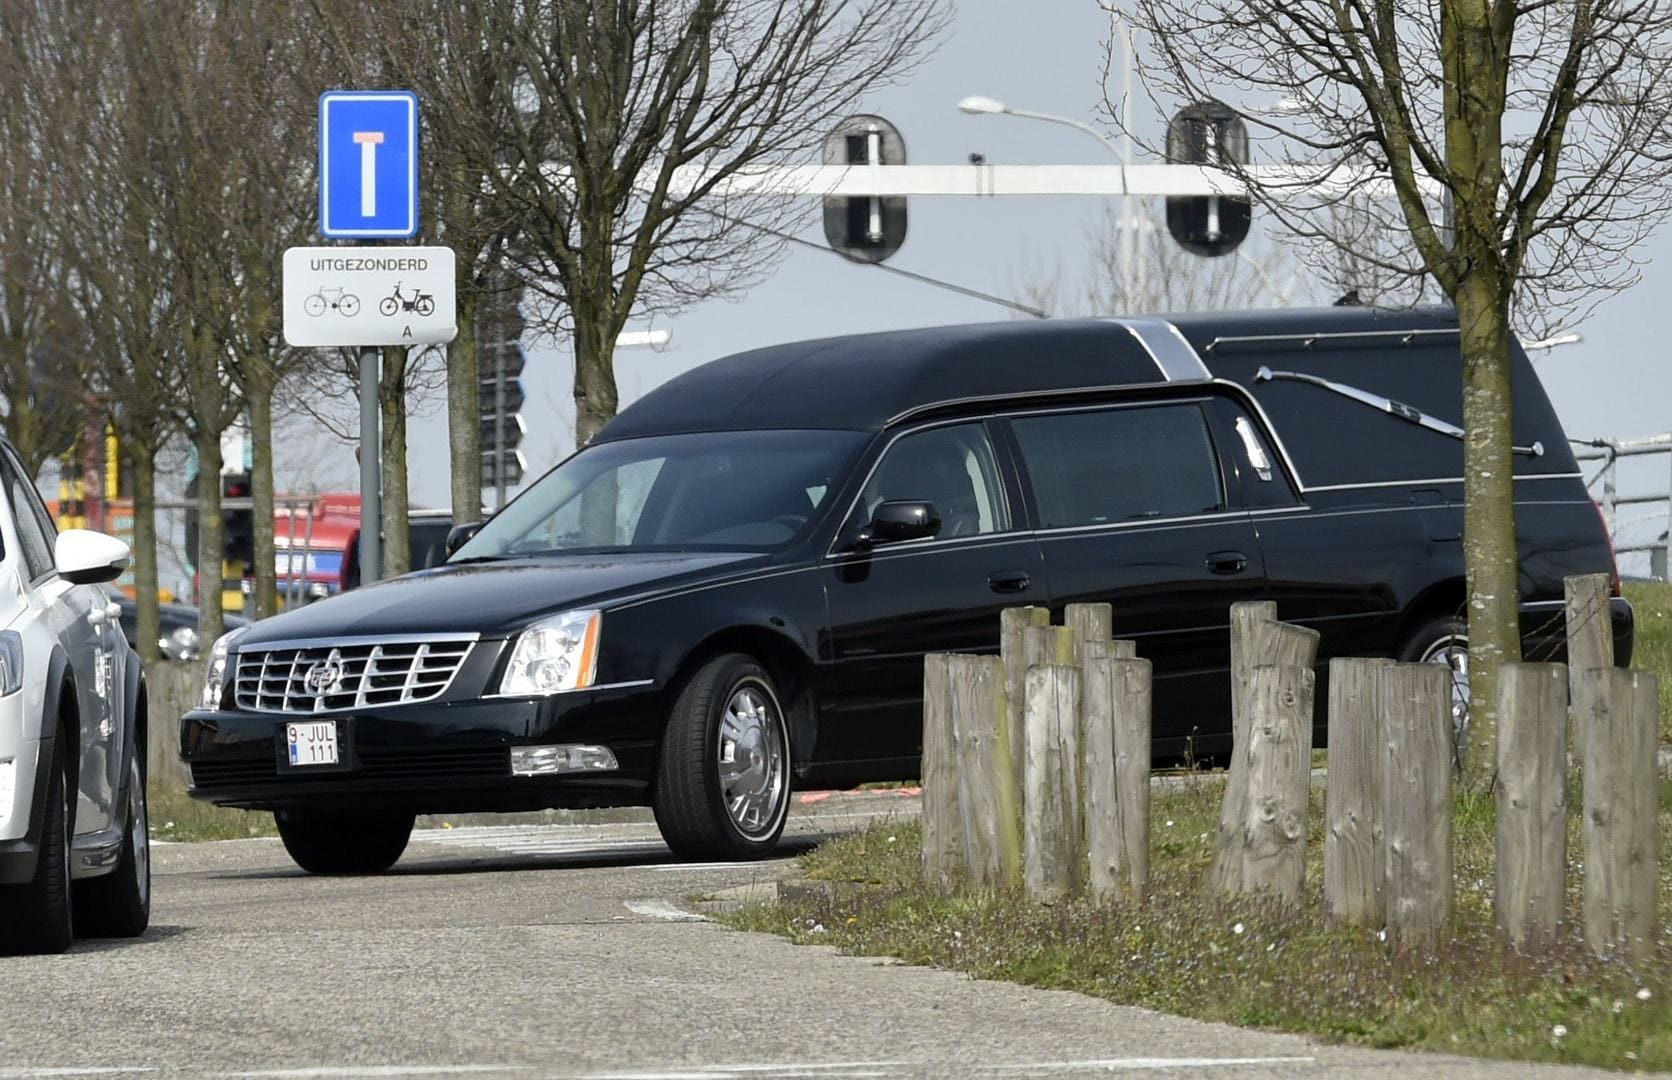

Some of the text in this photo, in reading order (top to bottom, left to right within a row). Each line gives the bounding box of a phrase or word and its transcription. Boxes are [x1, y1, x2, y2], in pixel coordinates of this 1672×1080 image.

[310, 258, 428, 271] UITGEZONDERD
[402, 326, 412, 338] A
[310, 744, 333, 760] 111
